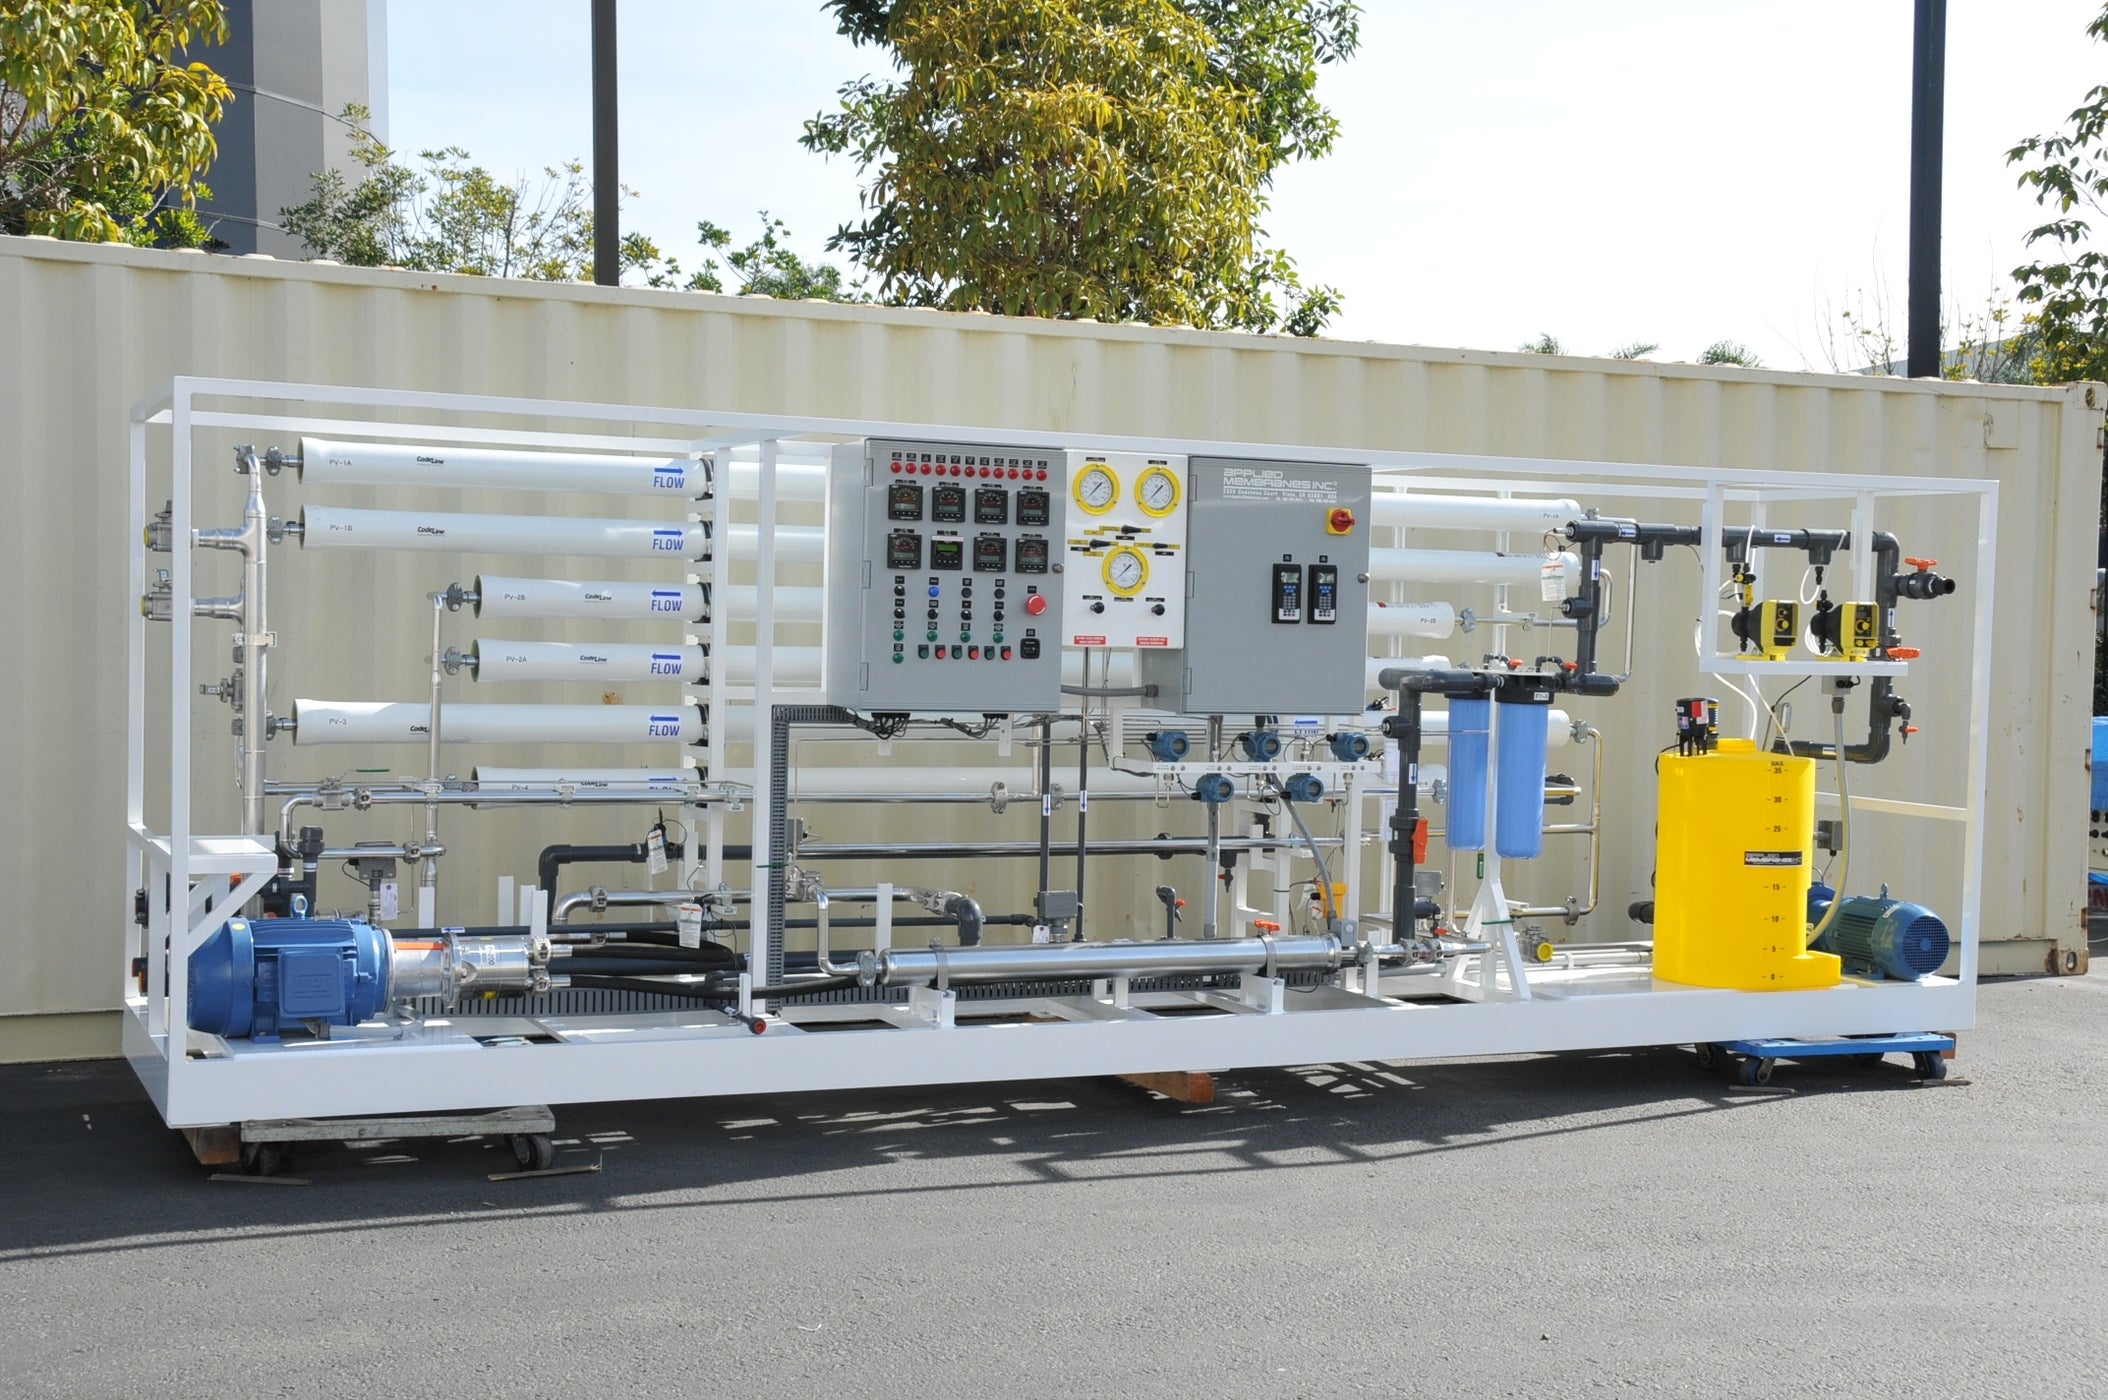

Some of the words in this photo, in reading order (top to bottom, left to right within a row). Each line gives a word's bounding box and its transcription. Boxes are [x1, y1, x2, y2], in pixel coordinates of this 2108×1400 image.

[328, 458, 352, 467] PV-1A
[416, 456, 445, 465] CodeLine
[653, 476, 685, 488] FLOW
[417, 526, 445, 535] CodeLine
[652, 539, 684, 551] FLOW
[504, 593, 526, 601] PV-2B
[651, 599, 683, 612] FLOW
[579, 655, 607, 663] CodeLine
[650, 662, 682, 675] FLOW
[648, 724, 680, 736] FLOW
[1772, 883, 1780, 891] 15
